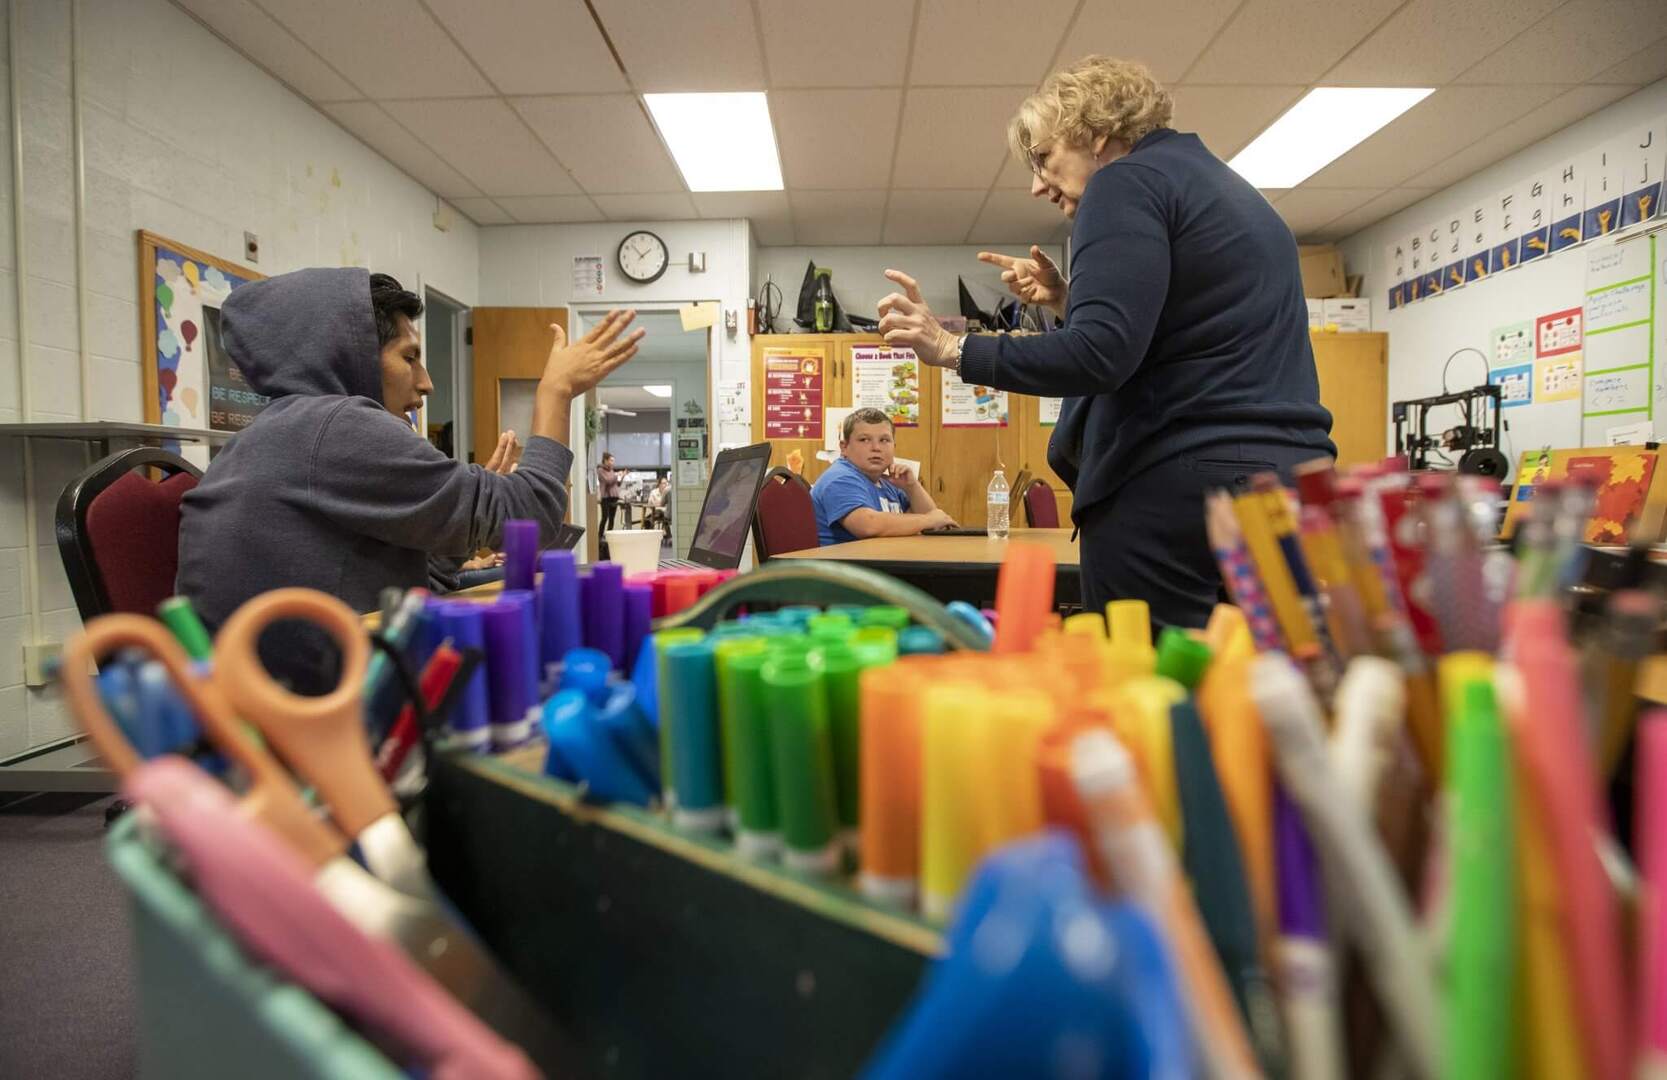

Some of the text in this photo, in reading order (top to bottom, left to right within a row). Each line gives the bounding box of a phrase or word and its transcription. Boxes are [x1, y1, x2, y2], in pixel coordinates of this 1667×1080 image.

[1395, 246, 1403, 258] A
[1412, 237, 1421, 251] B
[1430, 229, 1439, 242] C
[1450, 220, 1460, 234] D
[1474, 209, 1484, 223] E
[1502, 194, 1513, 211] F
[1531, 182, 1544, 198] G
[1563, 165, 1574, 184] H
[1639, 131, 1652, 149] J
[1451, 238, 1459, 254] d
[1475, 233, 1484, 244] e
[1532, 208, 1542, 228] g
[1563, 193, 1574, 208] h
[1640, 157, 1649, 184] j
[855, 352, 874, 360] Choose
[879, 352, 892, 360] Book
[894, 352, 905, 360] That
[212, 386, 226, 401] BE
[211, 411, 257, 427] BE RESP
